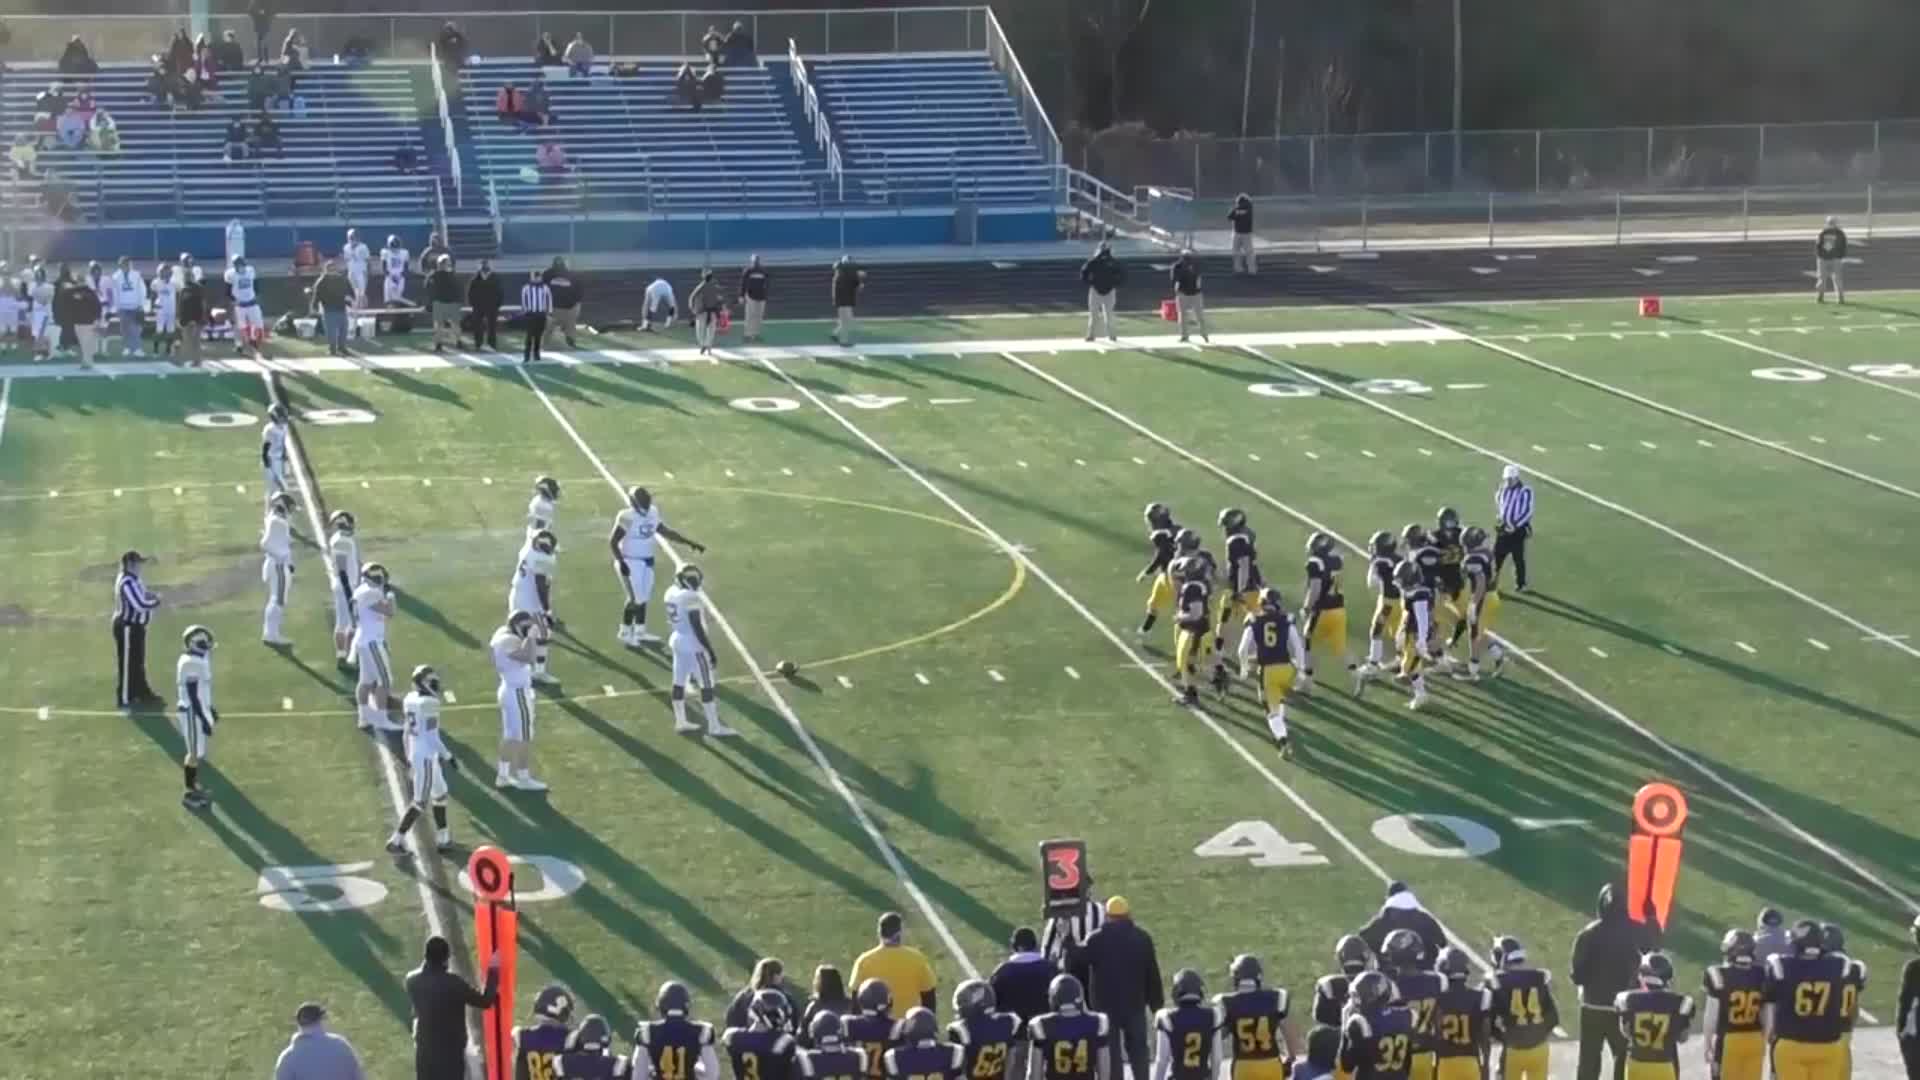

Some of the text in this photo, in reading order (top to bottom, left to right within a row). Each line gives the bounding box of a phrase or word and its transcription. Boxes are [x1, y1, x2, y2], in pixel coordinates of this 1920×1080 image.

[1263, 622, 1278, 648] 6
[1047, 848, 1080, 889] 3
[1511, 986, 1544, 1025] 44
[1729, 991, 1760, 1024] 26
[1795, 982, 1831, 1016] 67
[1237, 1016, 1271, 1051] 54
[1442, 1014, 1471, 1044] 21
[1634, 1012, 1670, 1048] 57
[660, 1045, 688, 1080] 41
[741, 1052, 760, 1080] 3
[973, 1042, 1008, 1077] 62
[1054, 1039, 1086, 1073] 64
[1183, 1032, 1201, 1068] 2
[1375, 1034, 1409, 1071] 33
